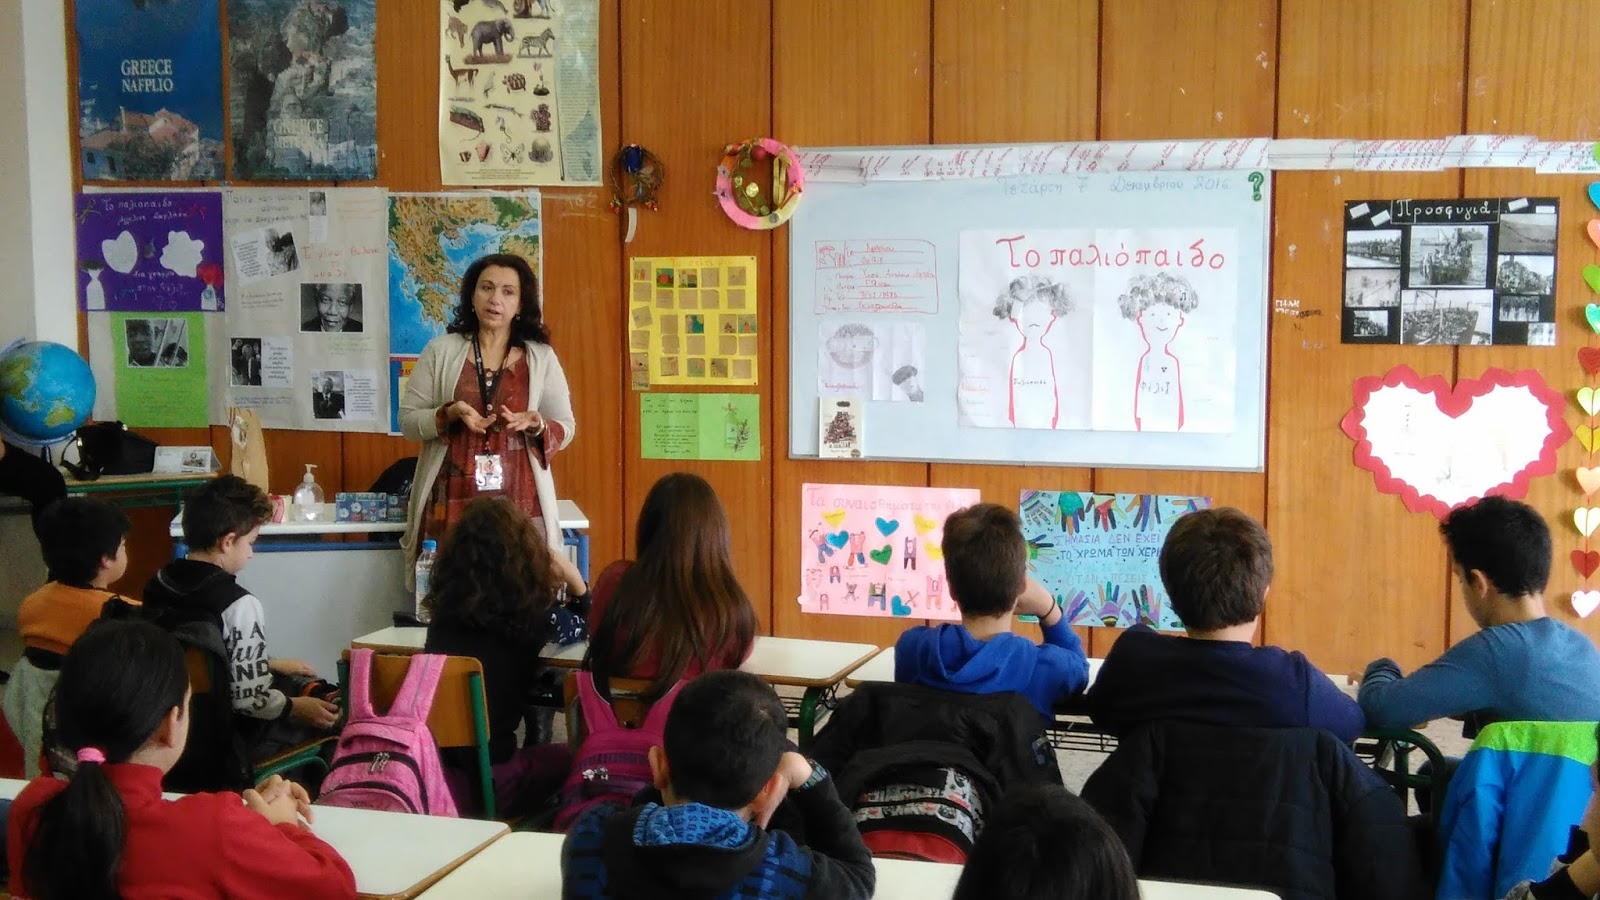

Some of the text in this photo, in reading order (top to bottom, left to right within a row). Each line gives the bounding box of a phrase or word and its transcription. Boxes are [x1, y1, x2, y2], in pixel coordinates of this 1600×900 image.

[121, 59, 172, 76] GREECE
[121, 79, 174, 93] NAFPLIO
[1077, 176, 1089, 193] 7
[996, 235, 1041, 268] Το
[1053, 533, 1161, 547] ΣΗΜΑΣΙΑ ΔΕΝ ΕΧΕΙ
[1060, 547, 1161, 560] ΤΟ ΧΡΩΜΑ ΤΩΝ ΧΕΡΙ
[231, 659, 270, 683] ND
